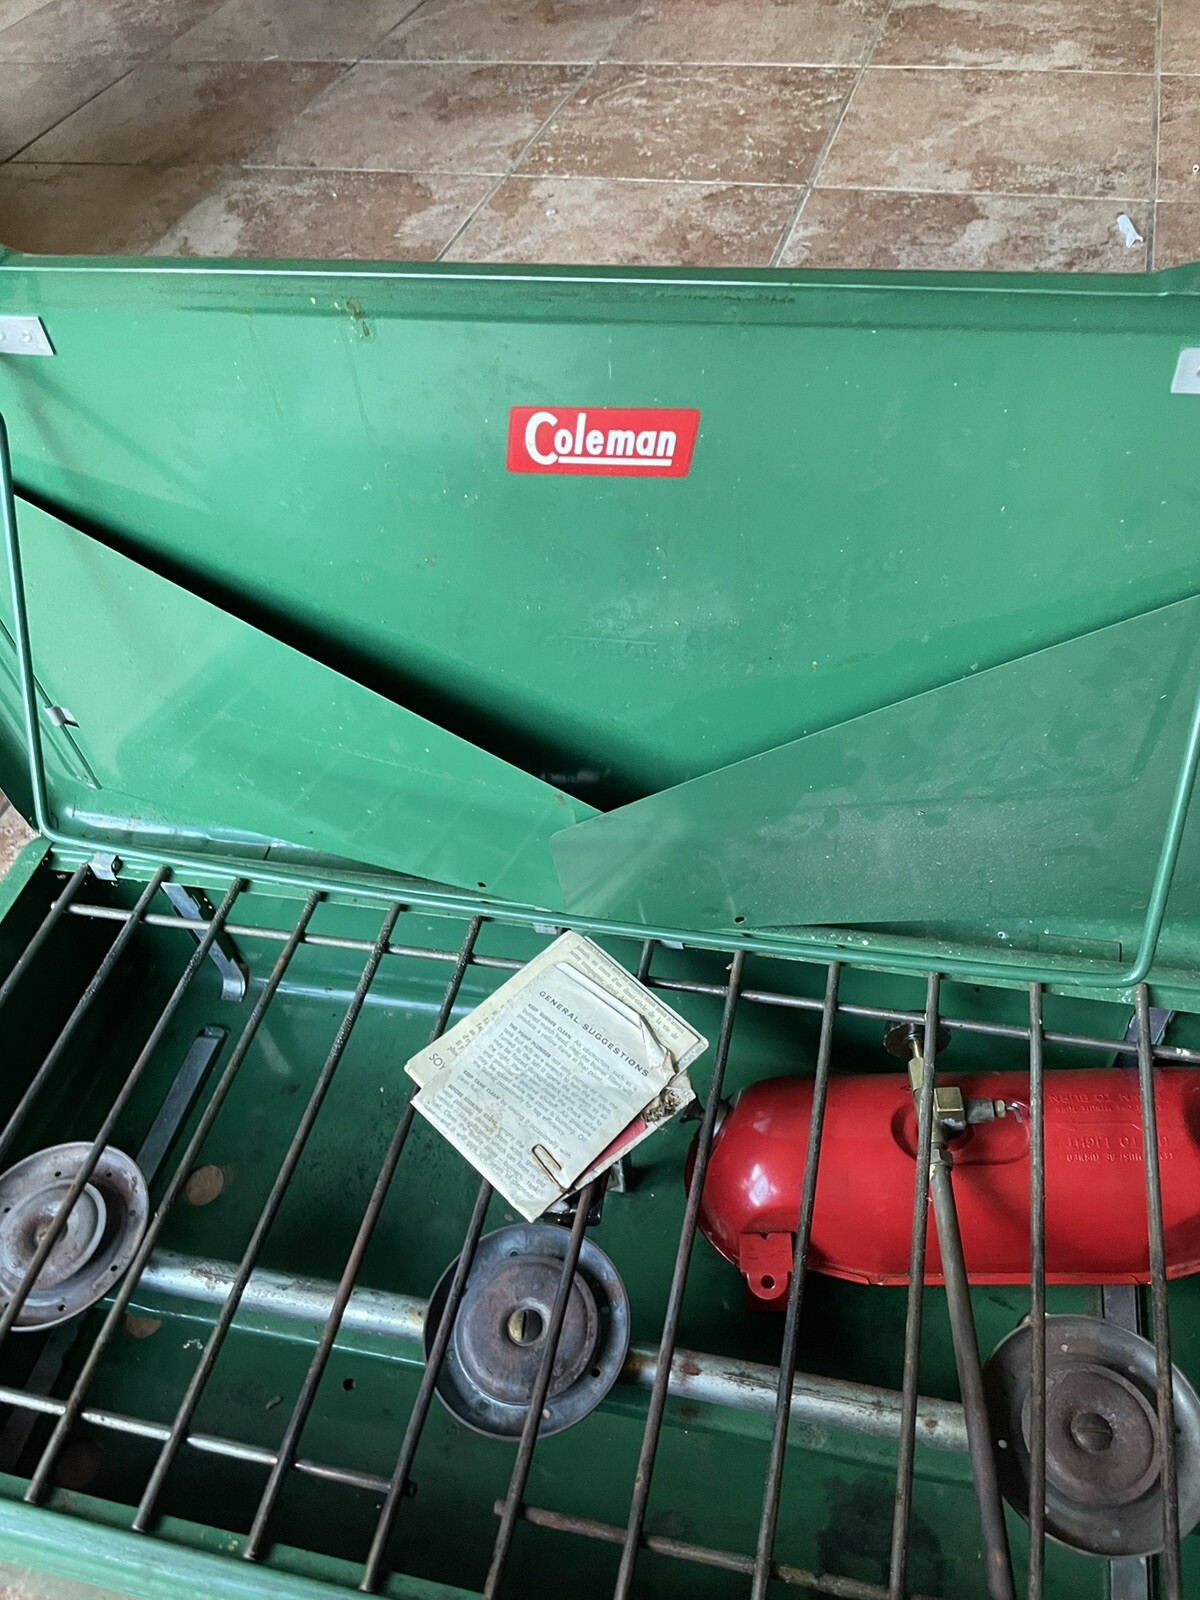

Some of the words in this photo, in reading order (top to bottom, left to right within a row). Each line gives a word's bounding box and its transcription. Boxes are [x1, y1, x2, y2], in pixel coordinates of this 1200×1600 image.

[525, 411, 676, 465] Coleman
[610, 976, 624, 988] d'un
[647, 1010, 656, 1018] de
[661, 1024, 671, 1033] vie
[670, 1031, 679, 1040] de
[654, 1006, 667, 1018] nous
[538, 990, 581, 1024] GENERAL
[580, 1022, 650, 1077] SUGGESTIONS
[515, 1046, 522, 1054] to
[530, 1058, 542, 1069] left
[576, 1060, 589, 1071] that
[485, 1087, 500, 1100] CLEAN
[1047, 1094, 1089, 1103] BURN
[1094, 1093, 1112, 1102] TO
[1065, 1136, 1110, 1150] LIGHT
[1119, 1136, 1136, 1149] TO
[534, 1176, 547, 1188] old
